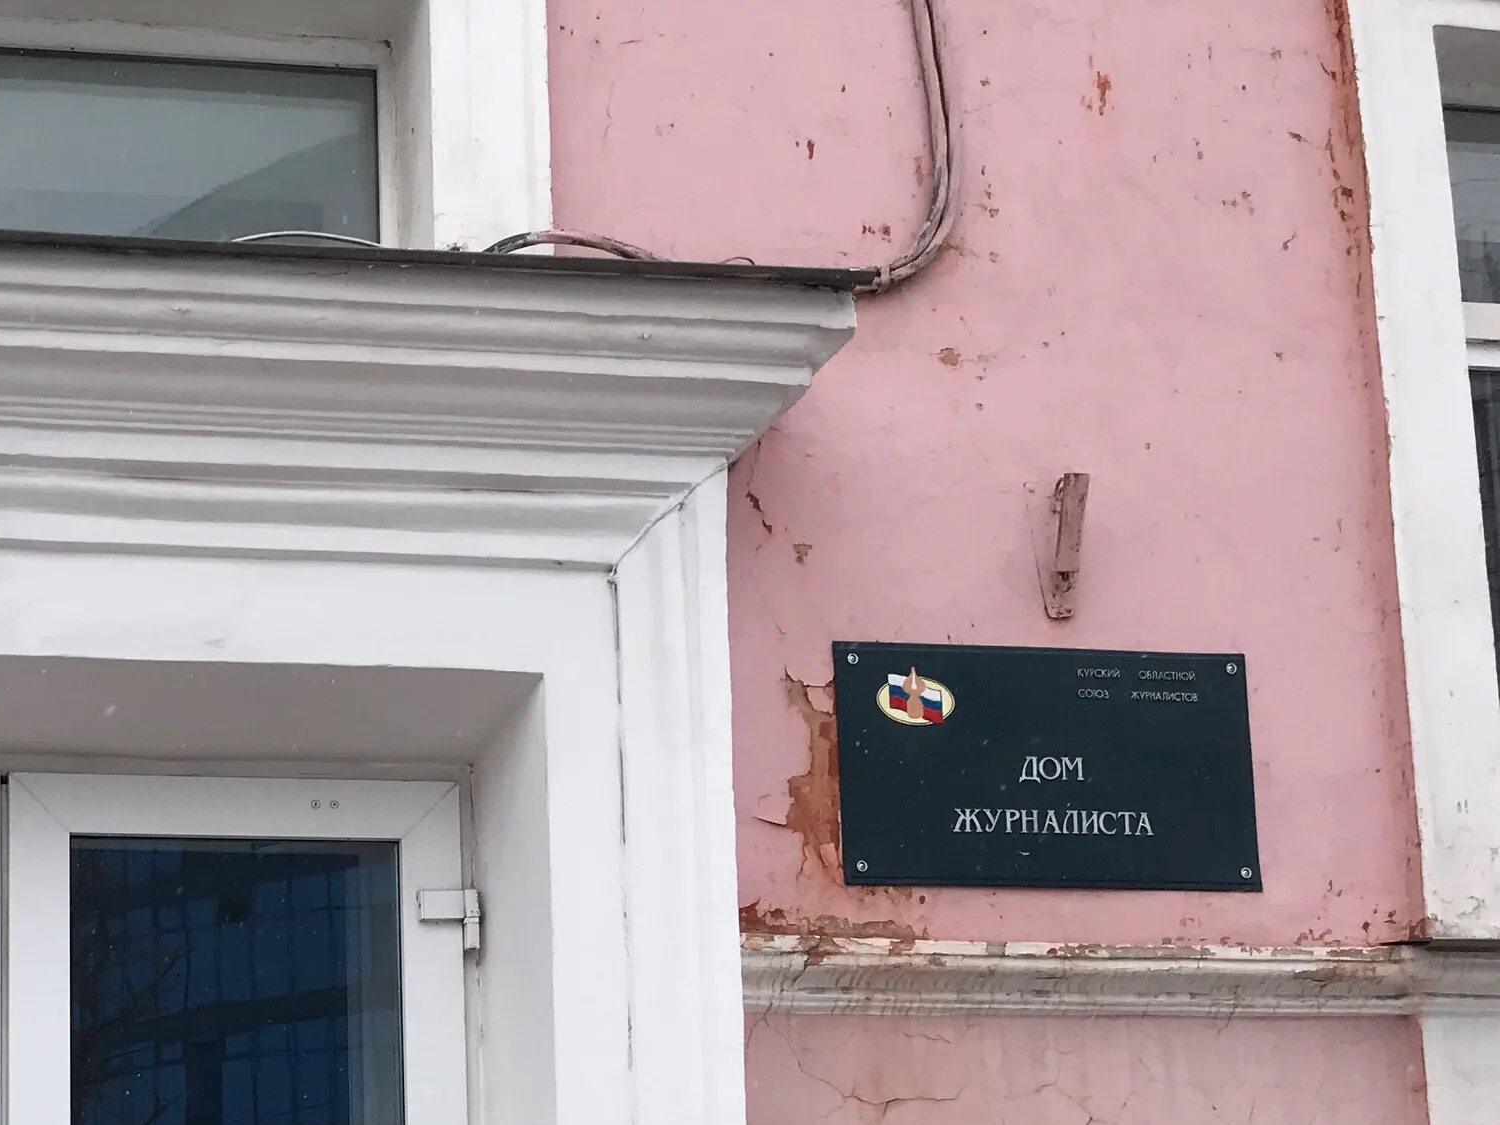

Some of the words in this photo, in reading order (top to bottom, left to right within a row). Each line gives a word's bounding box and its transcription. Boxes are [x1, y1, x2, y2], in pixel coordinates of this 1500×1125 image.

[1077, 667, 1120, 678] КУРСКИЙ
[1139, 670, 1196, 681] ОБЛАСТНОЙ
[1077, 688, 1109, 699] СОЮЗ
[1131, 690, 1198, 702] ЖУРНАЛИСТОВ
[1019, 756, 1085, 784] ДОМ
[952, 807, 1155, 836] ЖУРНАЛИСТА
